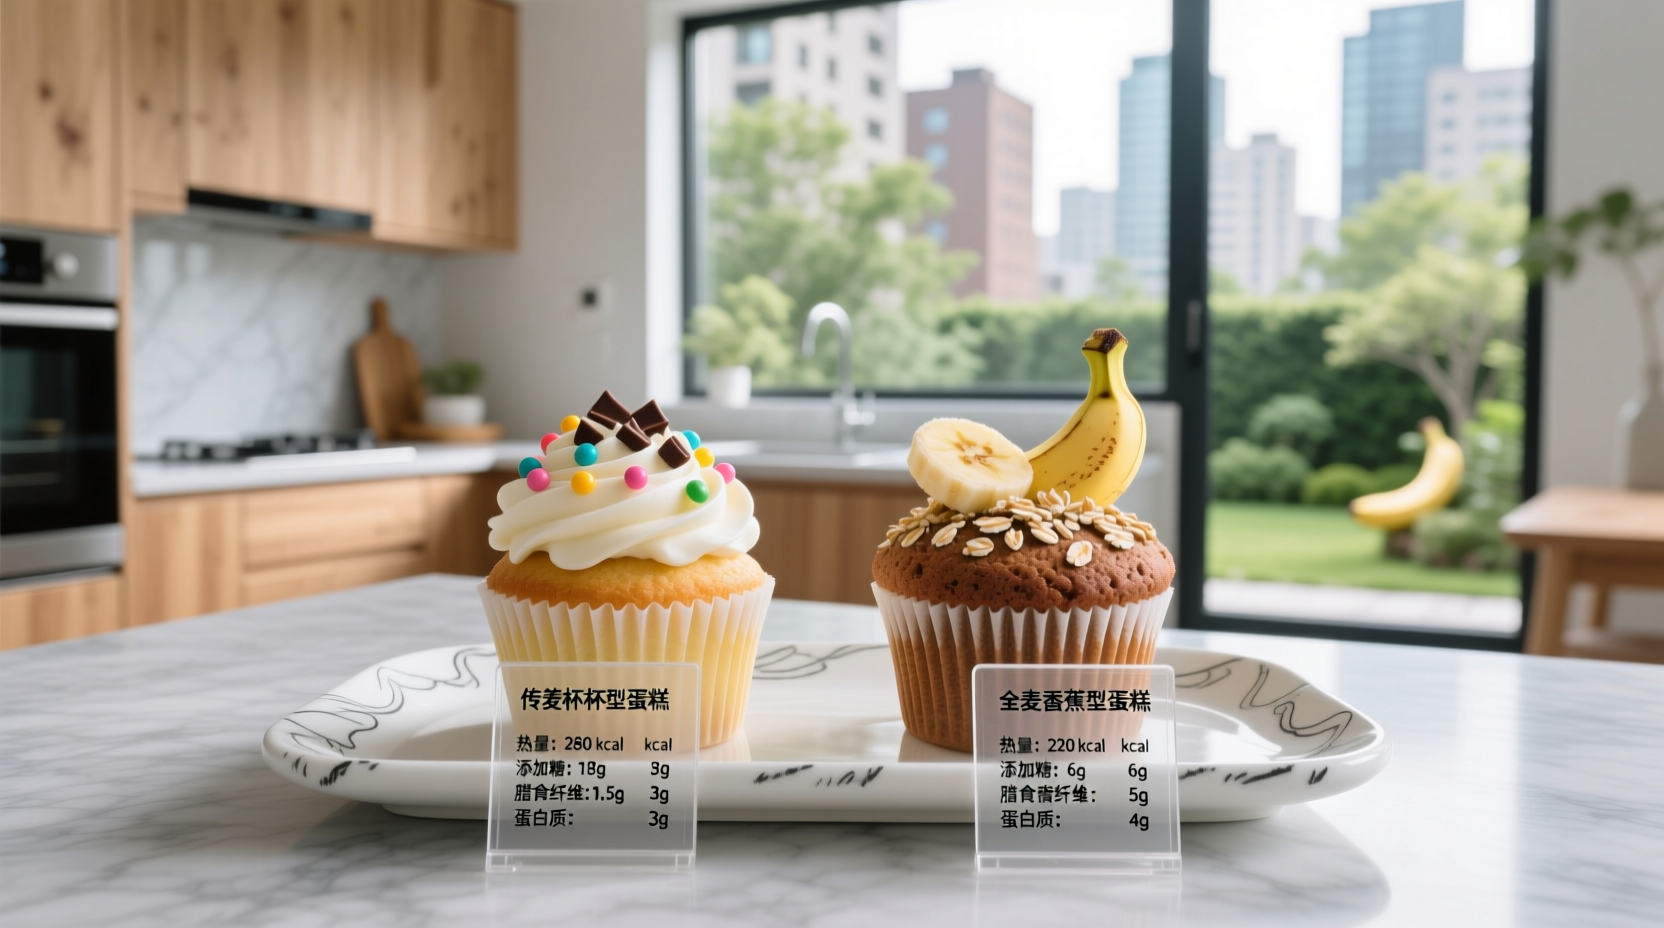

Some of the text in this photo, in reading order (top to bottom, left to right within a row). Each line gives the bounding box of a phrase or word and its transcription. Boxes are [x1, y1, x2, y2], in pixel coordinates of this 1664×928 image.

[1000, 688, 1151, 712] 全麦香蕉型蛋糕
[596, 737, 623, 751] kcal
[645, 737, 672, 751] kcal
[1048, 738, 1075, 752] 220
[1078, 738, 1105, 752] kcal
[1122, 738, 1148, 753] kcal
[1067, 762, 1085, 781] 6g
[1128, 763, 1147, 781] 6g
[650, 786, 668, 804] 3g
[1129, 787, 1148, 806] 5g
[515, 808, 668, 829] 蛋白质： 3g
[1001, 810, 1149, 831] 蛋白质： 4g
